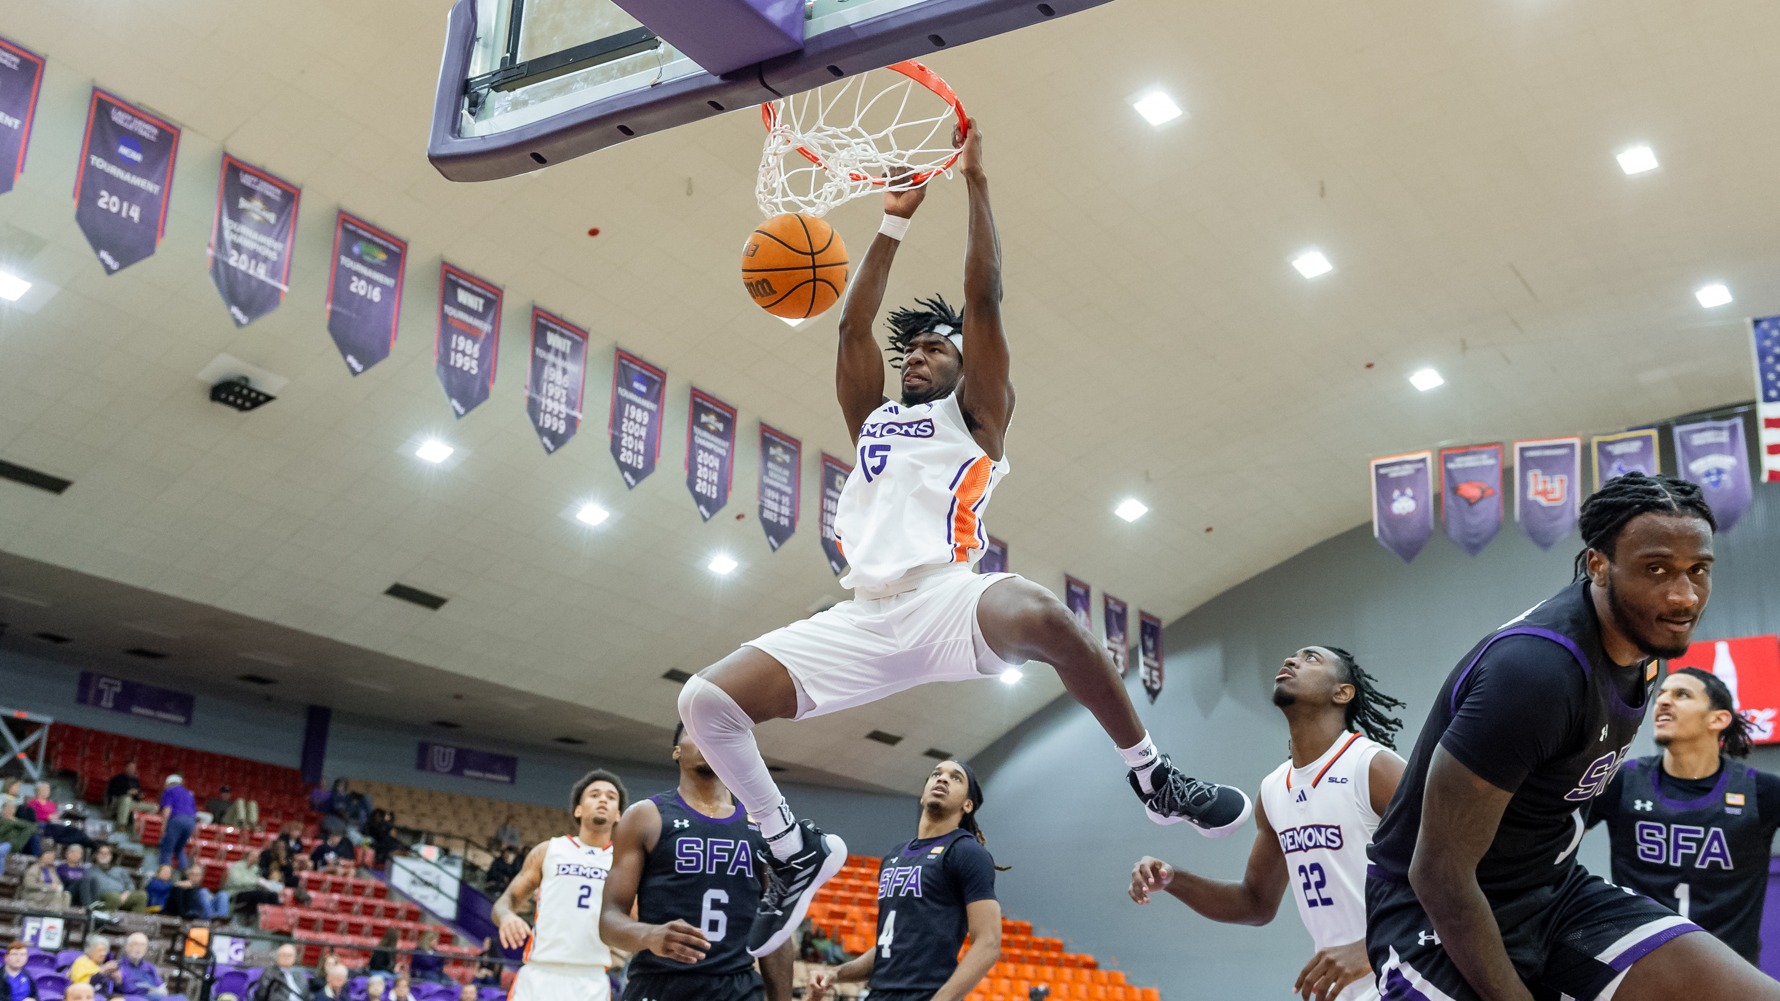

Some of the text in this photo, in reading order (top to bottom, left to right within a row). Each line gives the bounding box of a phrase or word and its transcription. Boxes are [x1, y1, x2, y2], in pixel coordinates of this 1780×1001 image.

[90, 155, 161, 195] TOURNAMENT
[97, 190, 142, 224] 2014
[228, 249, 268, 280] 2014
[349, 276, 382, 303] 2016
[451, 334, 481, 359] 1986
[449, 351, 479, 375] 1995
[538, 412, 566, 435] 1999
[624, 403, 650, 425] 1989
[621, 417, 647, 440] 2004
[859, 420, 933, 439] MONS
[620, 433, 645, 455] 2014
[619, 448, 644, 470] 2015
[860, 444, 892, 483] 15
[695, 477, 718, 500] 2015
[99, 677, 122, 708] T
[432, 745, 456, 774] U
[1280, 826, 1342, 852] DEMONS
[1635, 820, 1734, 870] SFA
[675, 837, 754, 877] SFA
[557, 863, 609, 881] DEMON
[877, 865, 923, 899] SFA
[1298, 862, 1334, 908] 22
[577, 884, 592, 909] 2
[1674, 882, 1690, 919] 1
[701, 888, 730, 943] 6
[877, 910, 897, 959] 4
